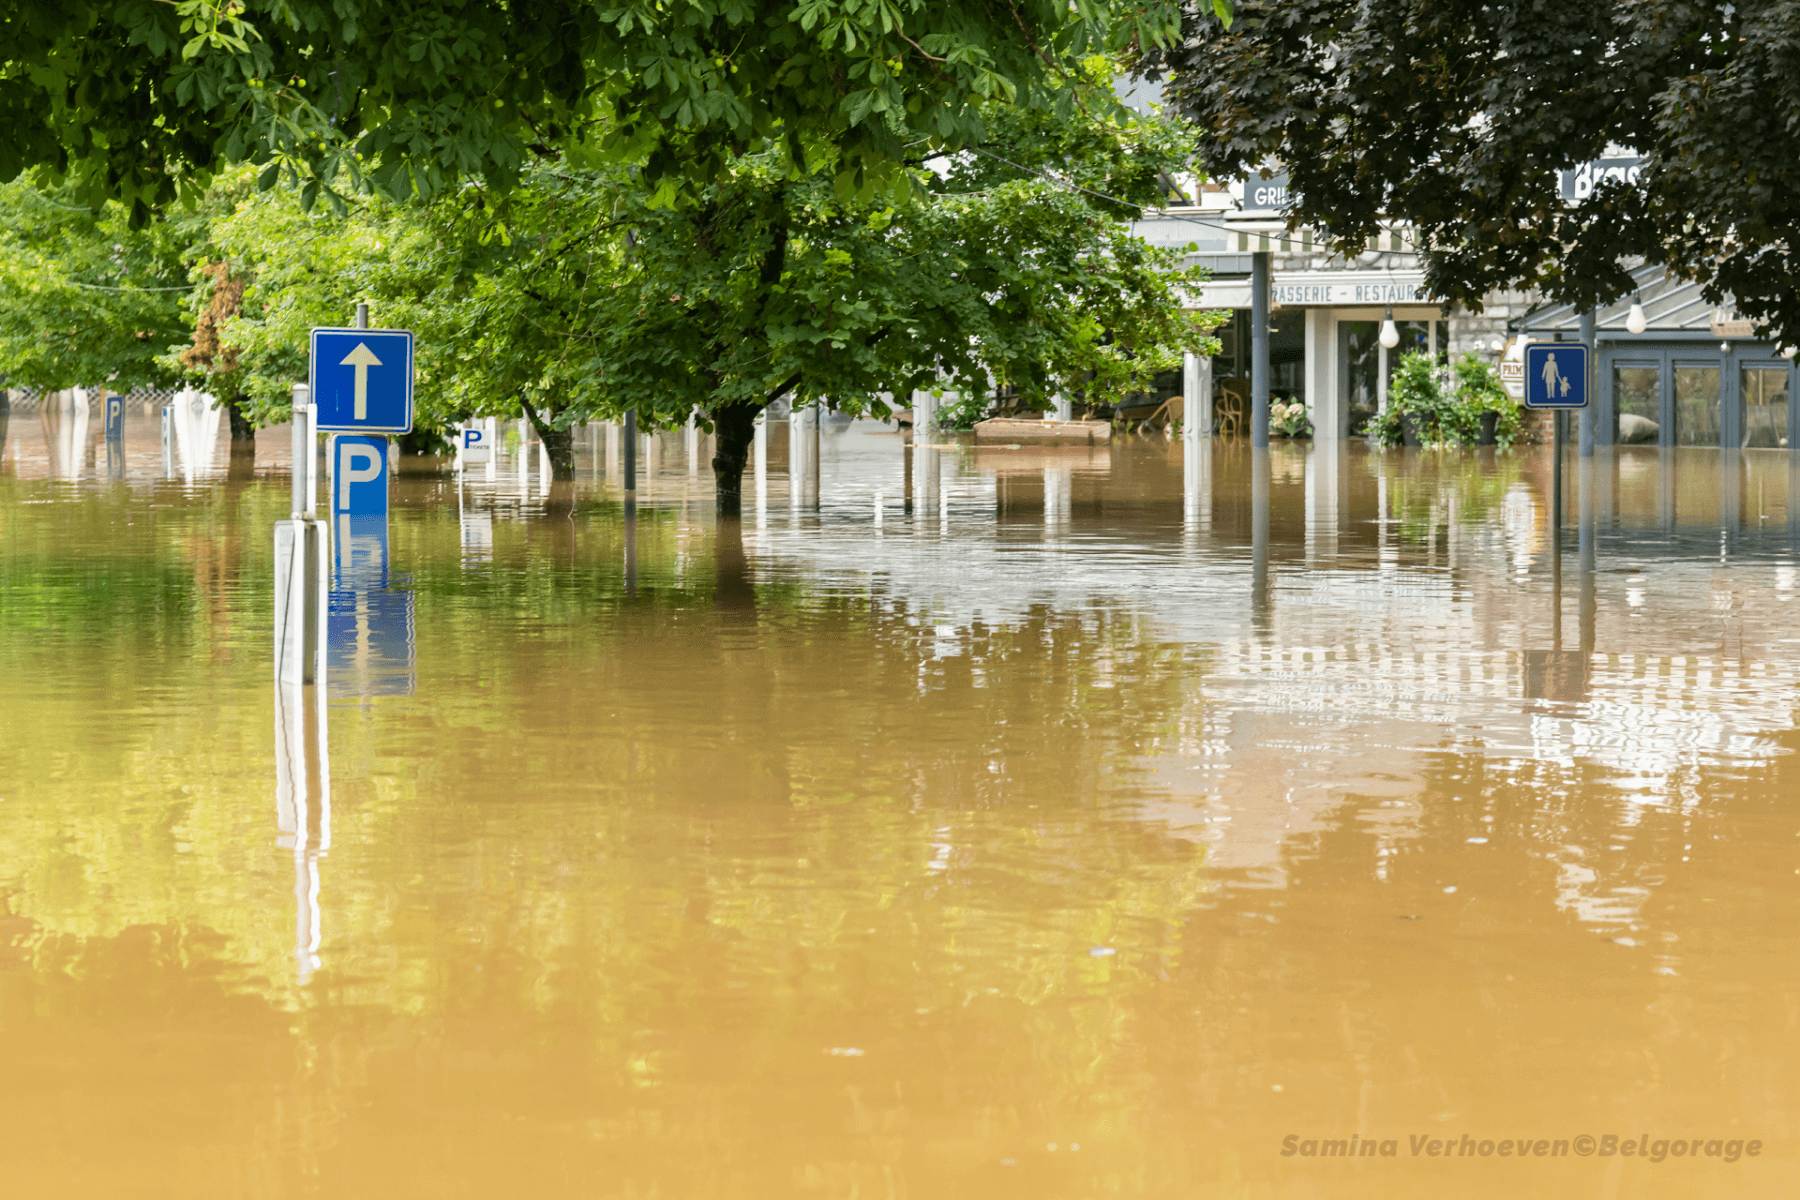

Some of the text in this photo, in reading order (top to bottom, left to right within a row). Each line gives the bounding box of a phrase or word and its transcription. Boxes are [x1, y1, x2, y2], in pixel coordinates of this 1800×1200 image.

[1575, 161, 1640, 198] Bras
[1254, 187, 1288, 206] GRIL
[1271, 286, 1332, 302] RASSERIE
[1356, 284, 1428, 301] RESTAUR
[1503, 364, 1524, 375] PRIM
[110, 401, 120, 429] P
[465, 430, 482, 449] P
[339, 443, 382, 510] P
